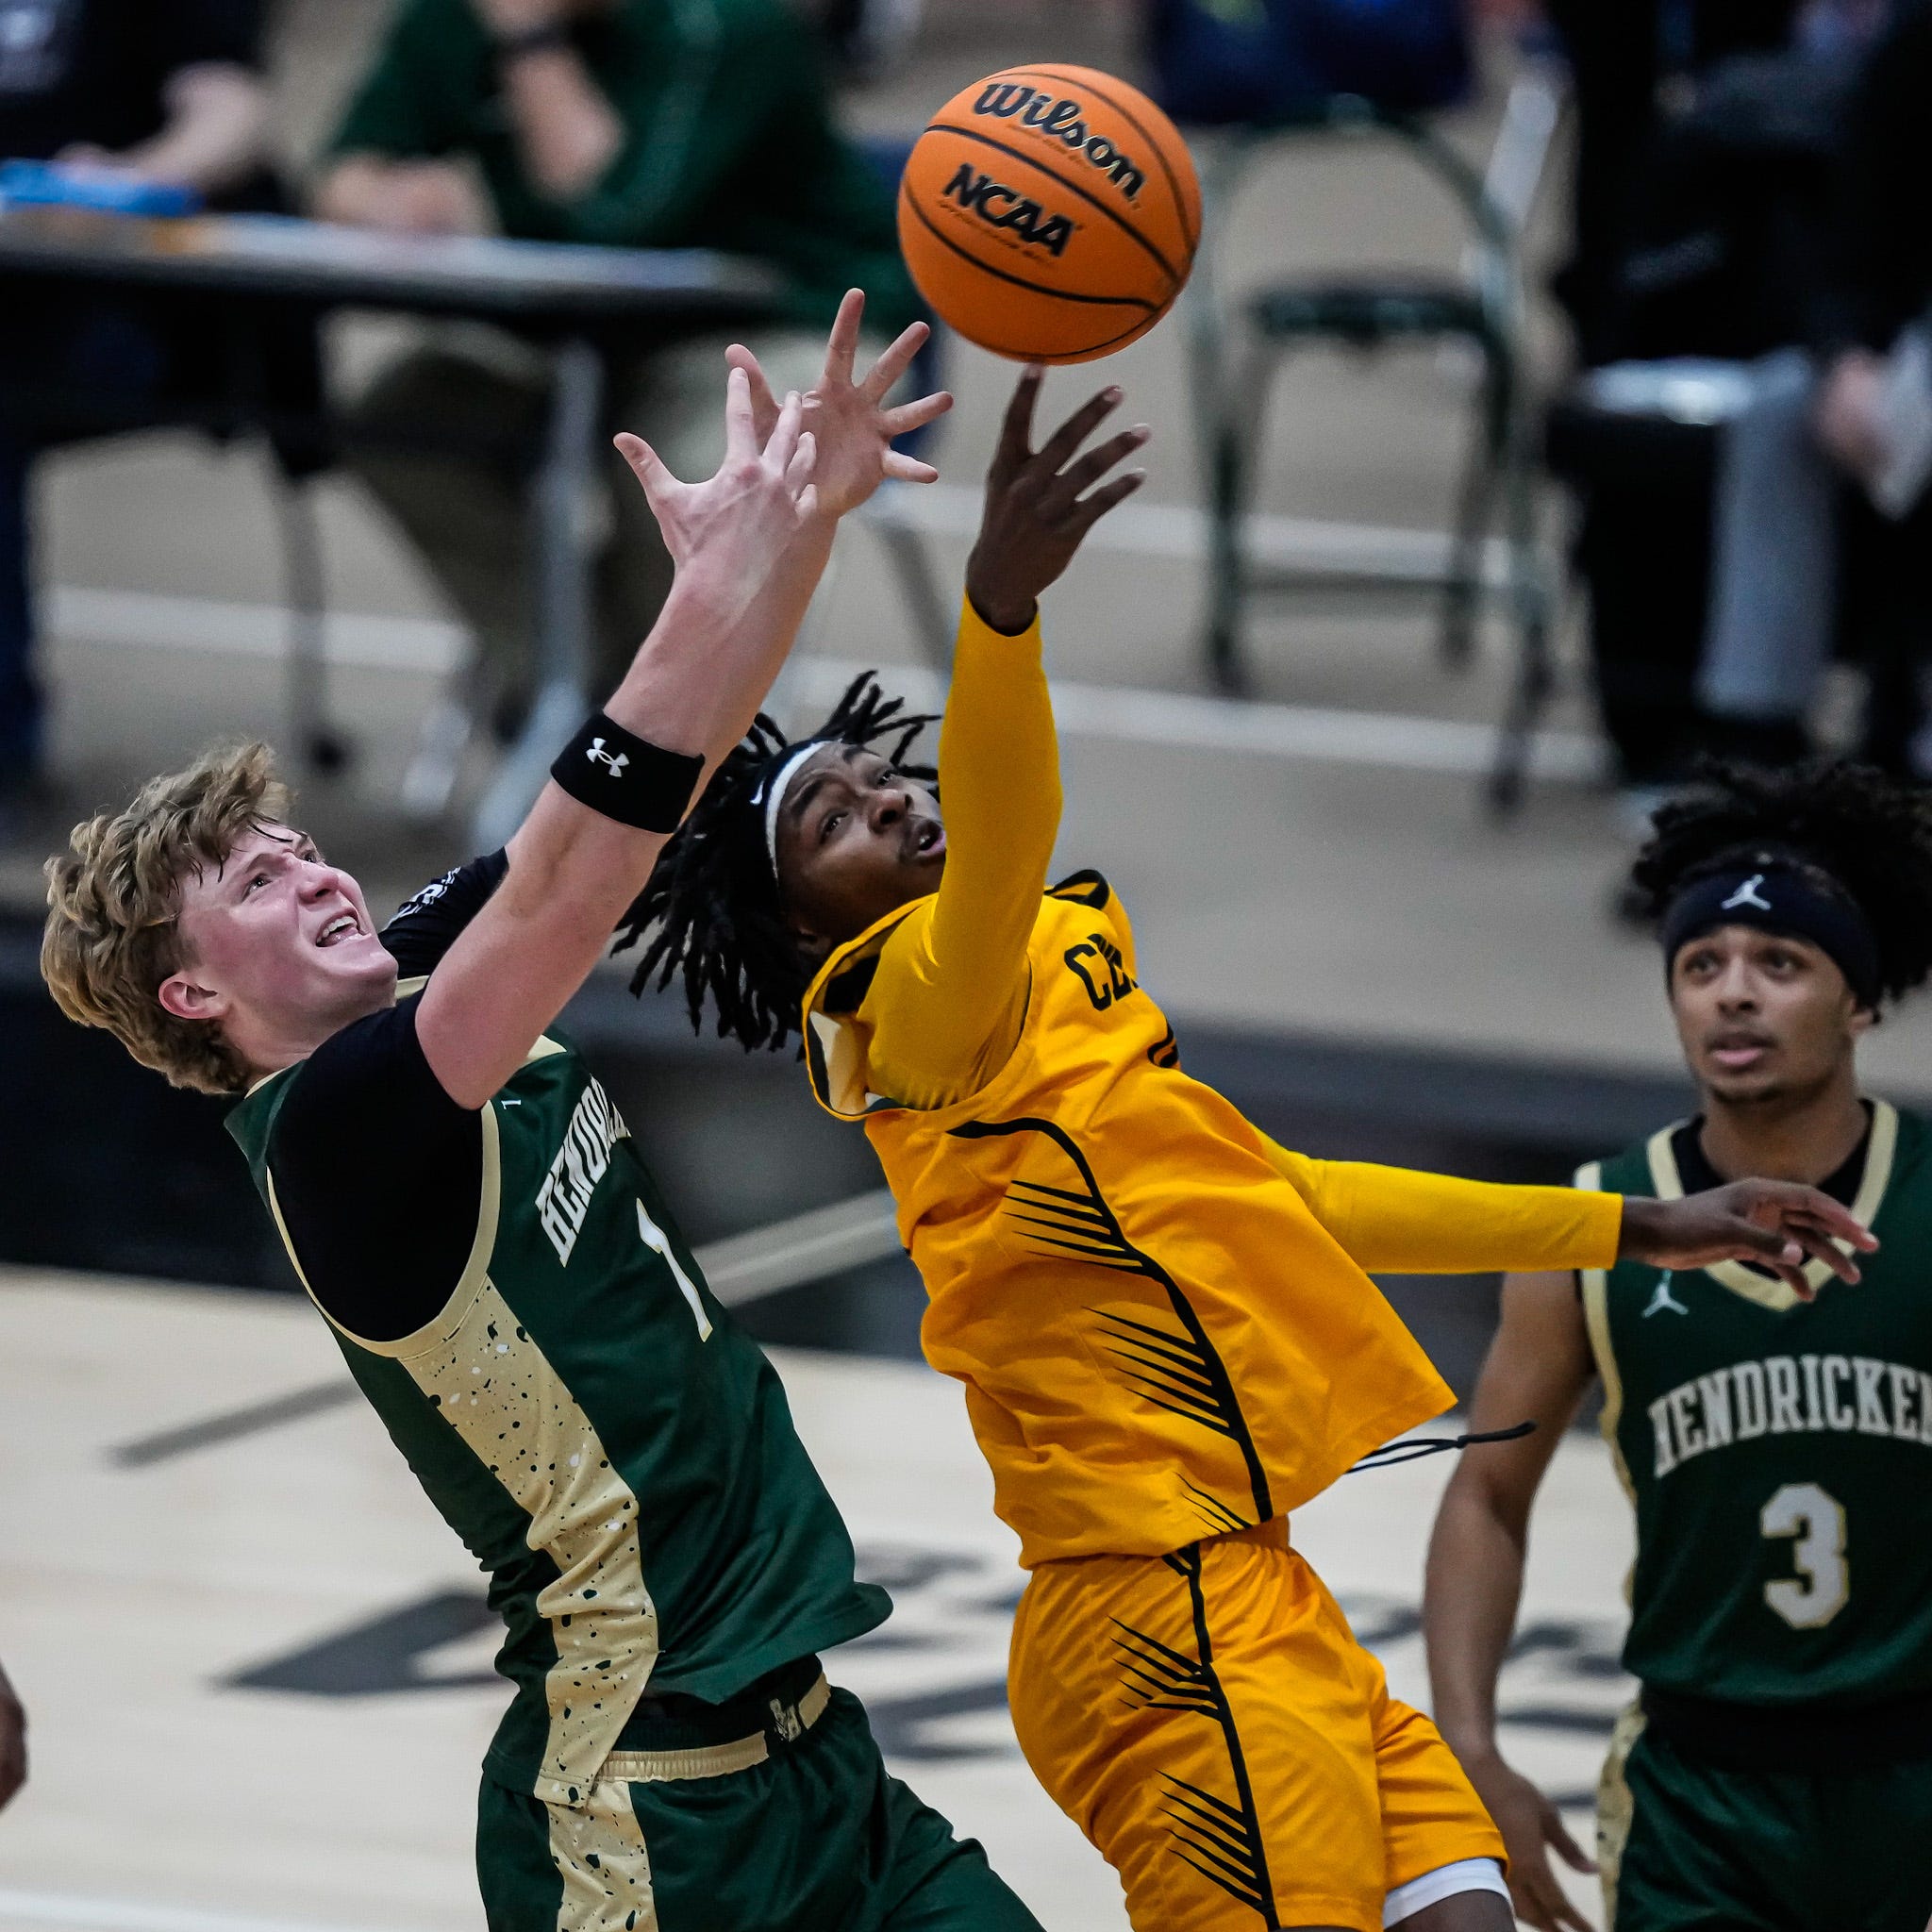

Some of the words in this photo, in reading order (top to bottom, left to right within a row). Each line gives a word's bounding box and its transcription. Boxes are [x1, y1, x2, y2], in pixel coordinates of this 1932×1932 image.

[974, 83, 1146, 200] Wilson
[942, 162, 1075, 258] NCAA
[635, 1197, 713, 1342] 1
[1759, 1482, 1849, 1630] 3
